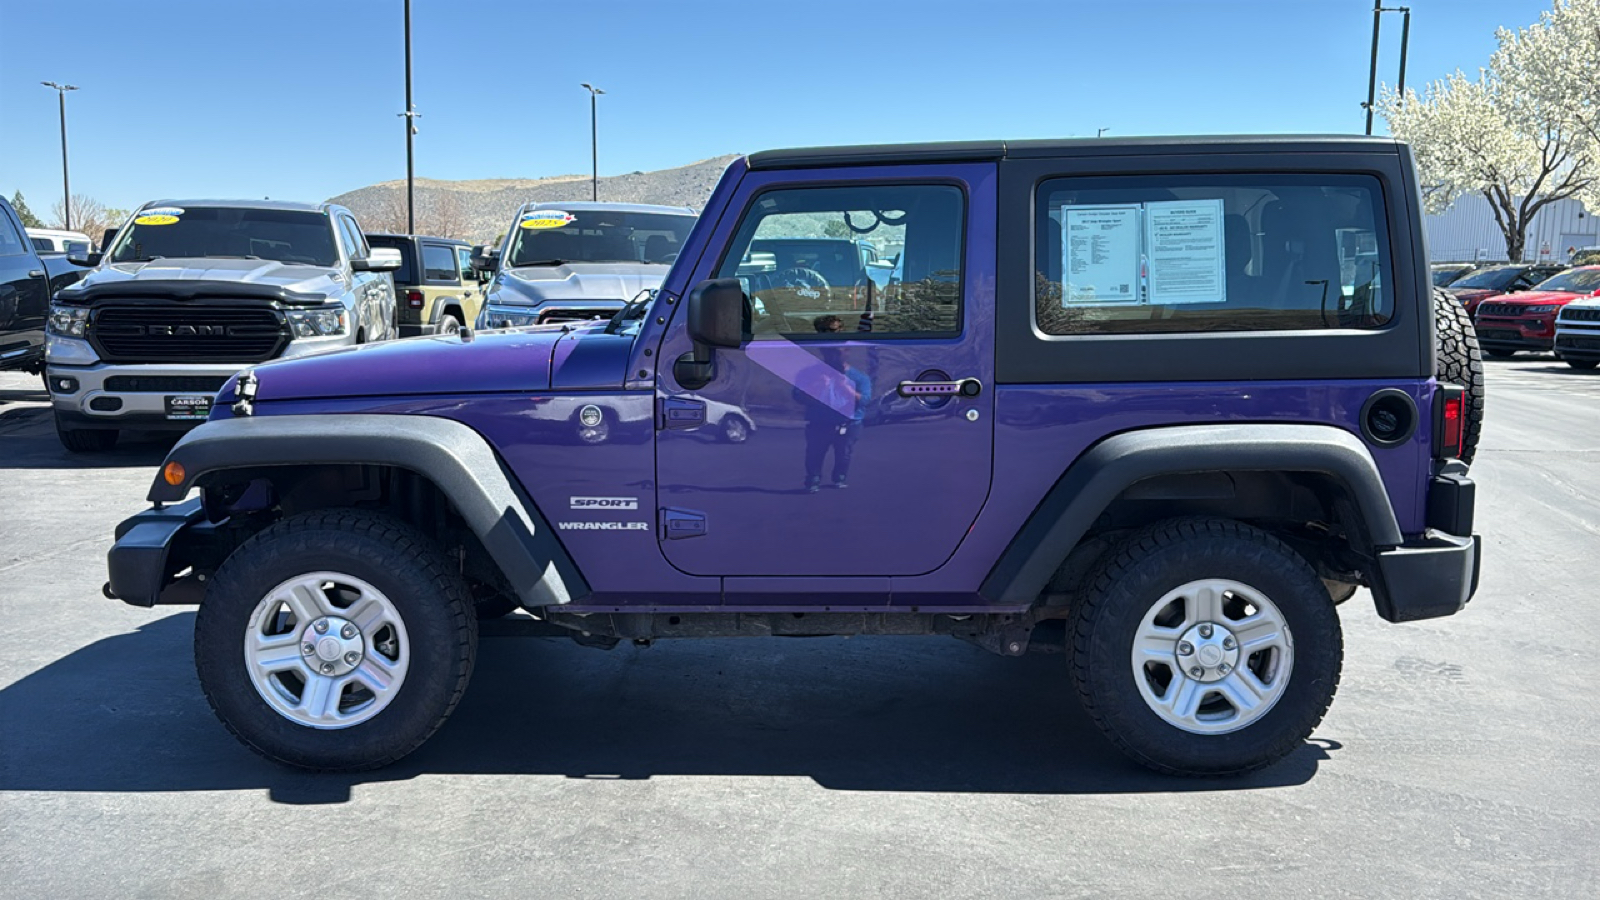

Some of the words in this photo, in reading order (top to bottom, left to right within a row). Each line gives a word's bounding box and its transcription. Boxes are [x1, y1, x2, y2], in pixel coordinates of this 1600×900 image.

[797, 288, 821, 300] Jeep
[148, 325, 223, 335] RAM
[574, 499, 633, 507] SPORT
[558, 522, 649, 531] WRANGLER
